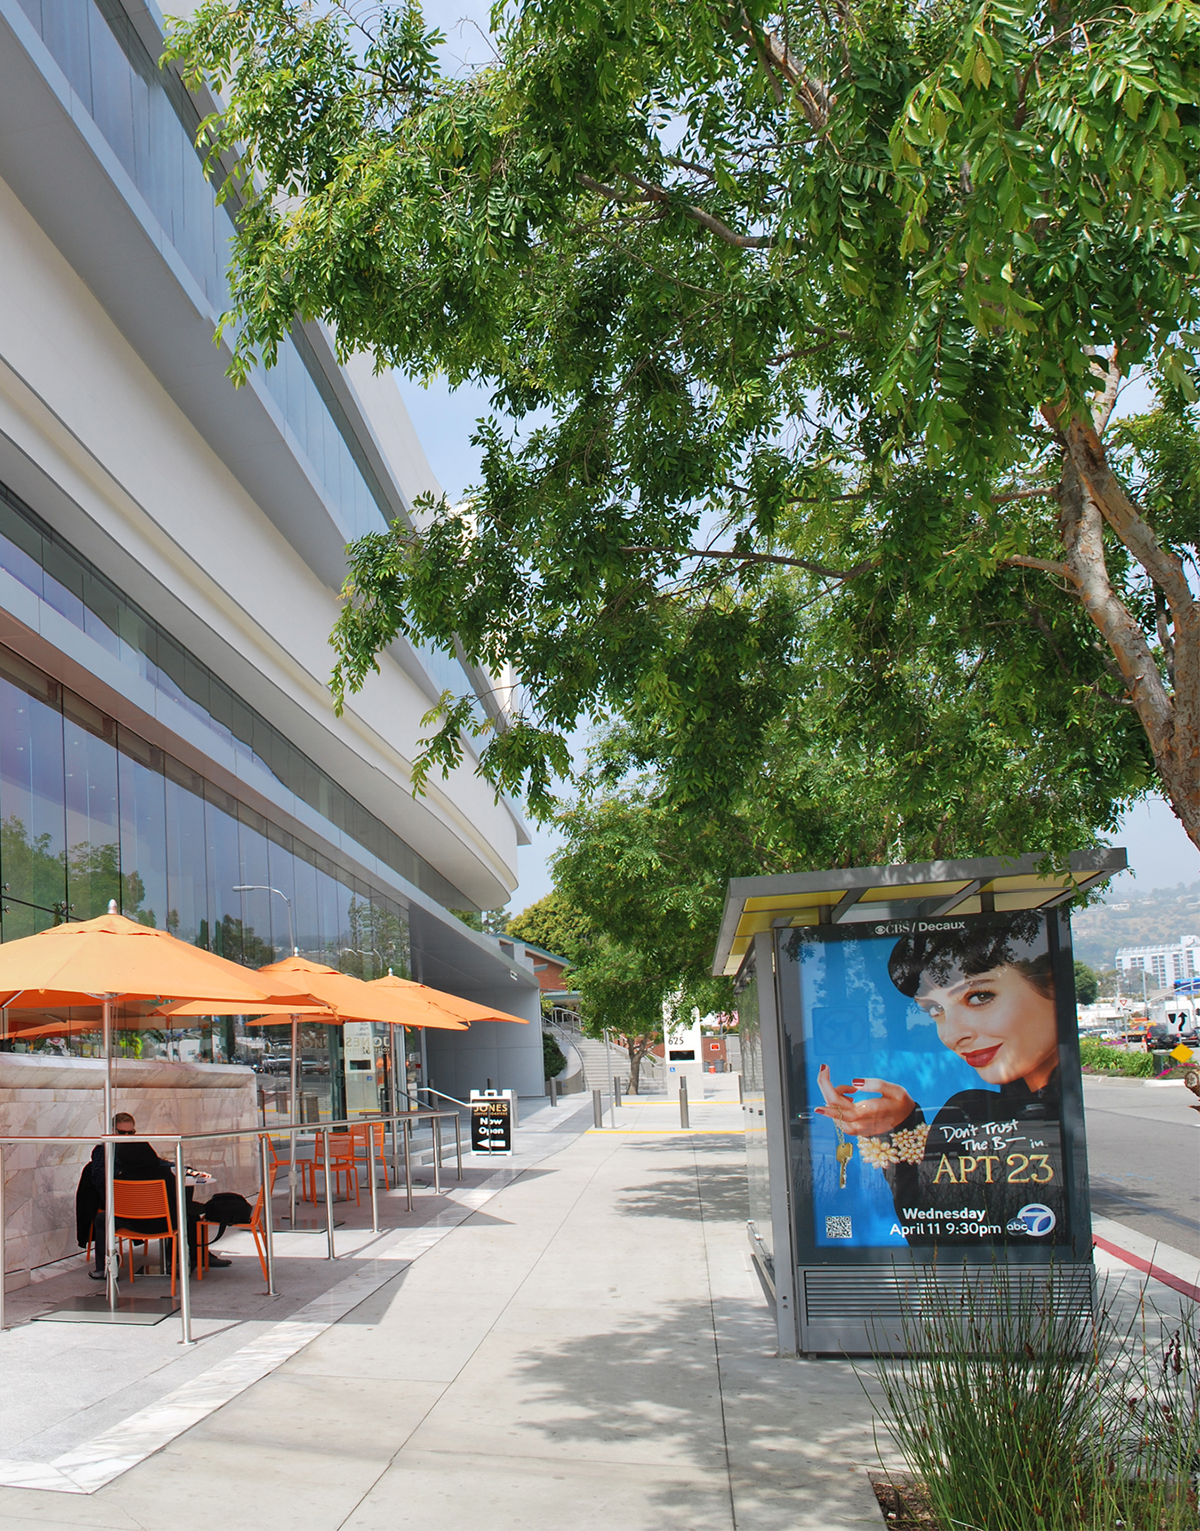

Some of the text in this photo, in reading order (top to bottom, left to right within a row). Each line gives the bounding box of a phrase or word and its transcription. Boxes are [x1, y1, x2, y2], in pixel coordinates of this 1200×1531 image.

[885, 924, 910, 934] CBS
[918, 921, 966, 932] Decaux
[668, 1036, 684, 1045] 625
[473, 1103, 508, 1113] JONES
[480, 1117, 503, 1125] Now
[478, 1126, 504, 1136] Open
[939, 1119, 1019, 1143] Don't Trust
[961, 1139, 988, 1151] The
[1029, 1138, 1044, 1149] in
[932, 1153, 1054, 1184] APT 23
[902, 1207, 986, 1222] Wednesday
[889, 1222, 1002, 1238] April 11 9:30pm
[1006, 1221, 1028, 1231] abc
